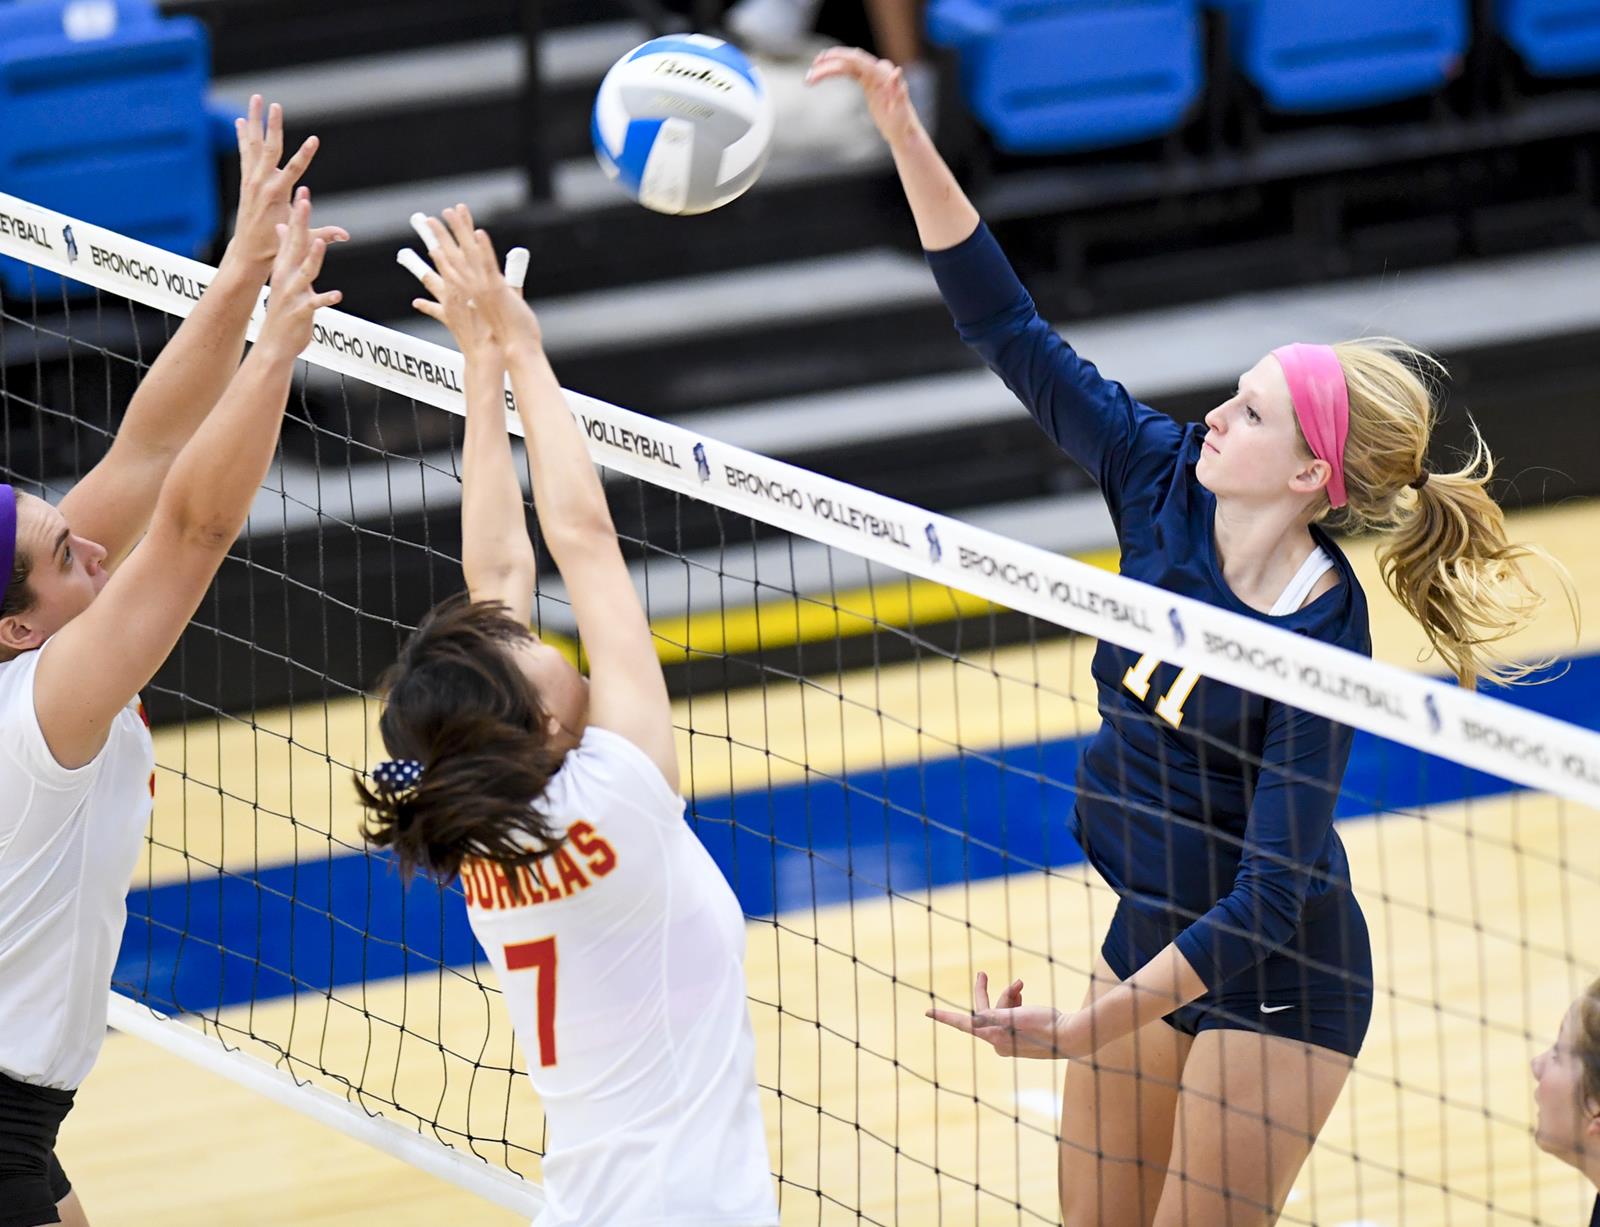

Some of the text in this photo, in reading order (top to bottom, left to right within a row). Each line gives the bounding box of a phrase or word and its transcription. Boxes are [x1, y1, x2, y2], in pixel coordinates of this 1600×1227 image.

[0, 212, 53, 249] EYBALL
[90, 245, 208, 301] BRONCHO VOLLE
[312, 323, 463, 393] ONCHO VOLLEYBALL
[581, 415, 681, 468] VOLLEYBALL
[724, 465, 911, 548] BRONCHO VOLLEYBALL
[958, 547, 1154, 633] BRONCHO VOLLEYBALL
[503, 934, 557, 1068] 7
